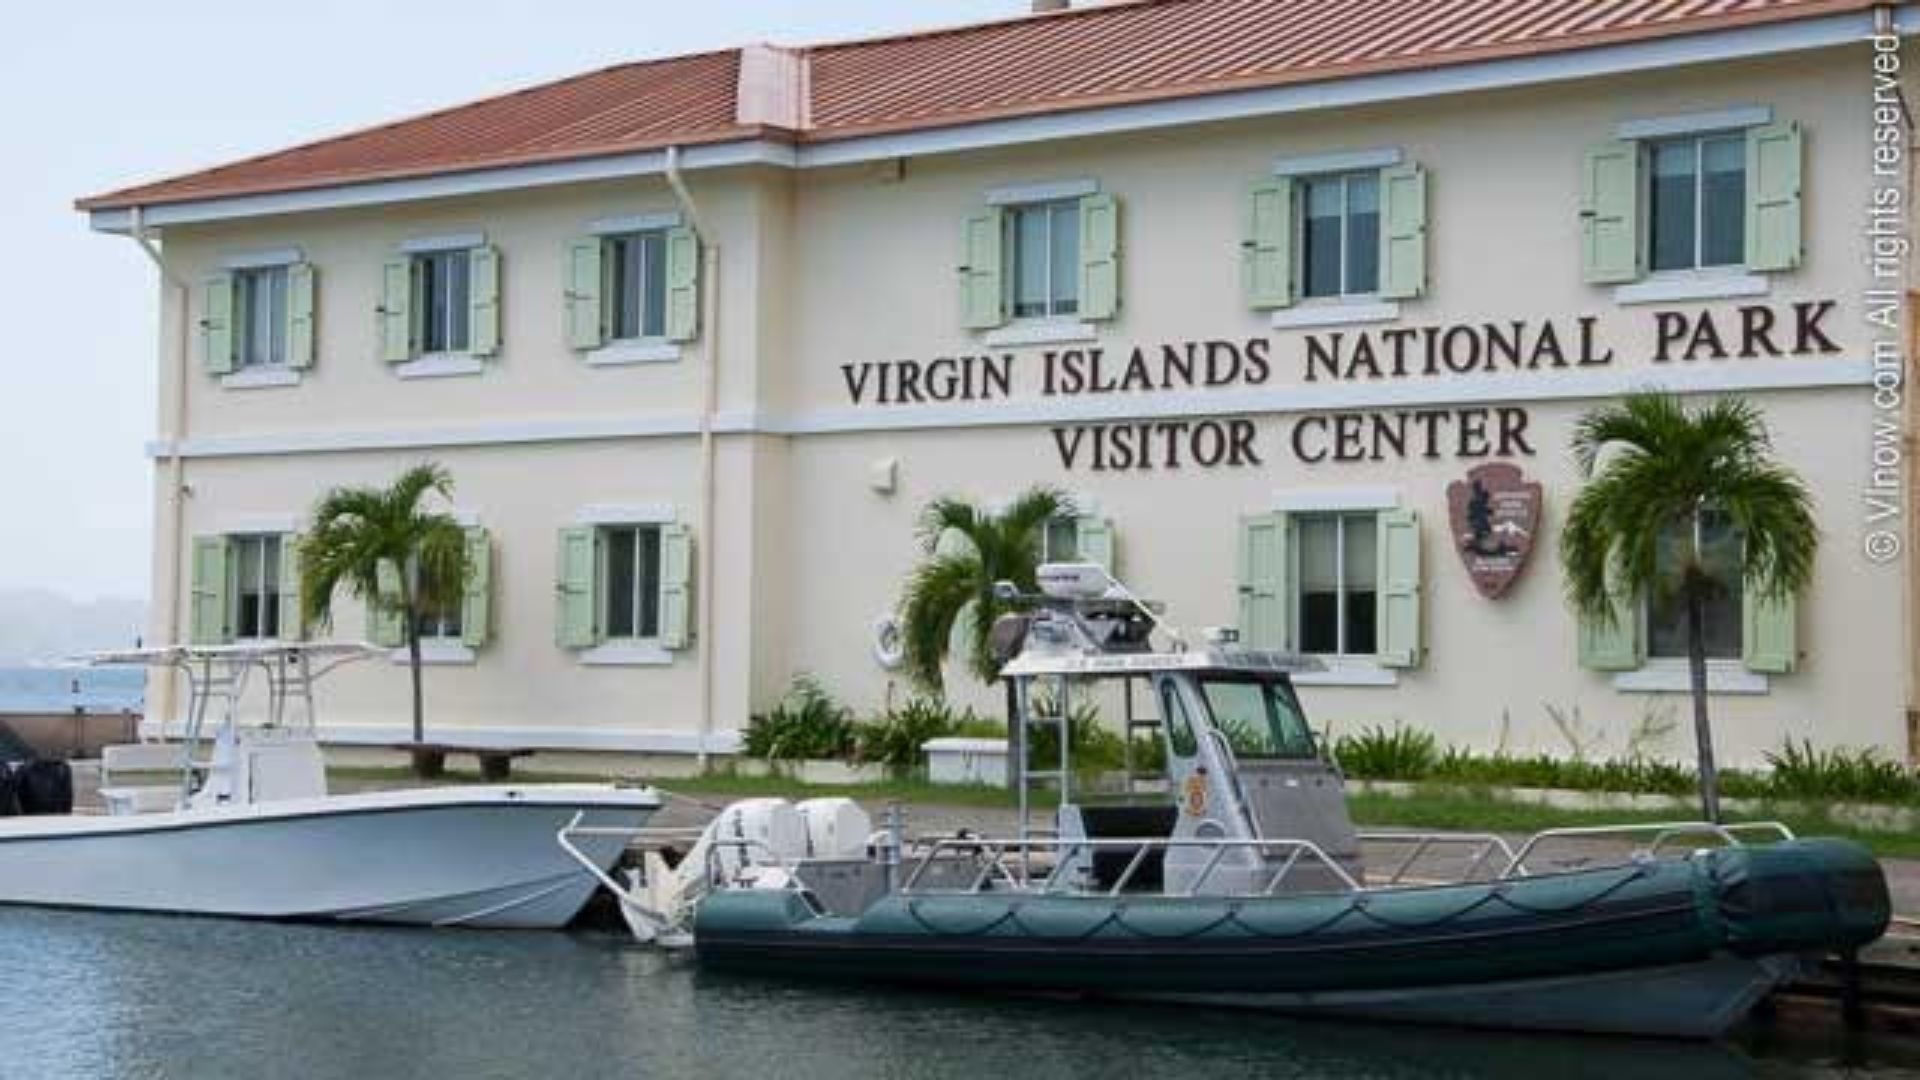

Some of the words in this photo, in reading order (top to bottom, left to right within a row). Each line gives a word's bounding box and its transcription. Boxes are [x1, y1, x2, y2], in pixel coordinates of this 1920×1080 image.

[841, 354, 1014, 405] VIRGIN
[1041, 338, 1271, 396] ISLANDS
[1303, 316, 1614, 382] NATIONAL
[1653, 299, 1843, 363] PARK
[1052, 418, 1261, 471] VISITOR
[1292, 406, 1536, 463] CENTER
